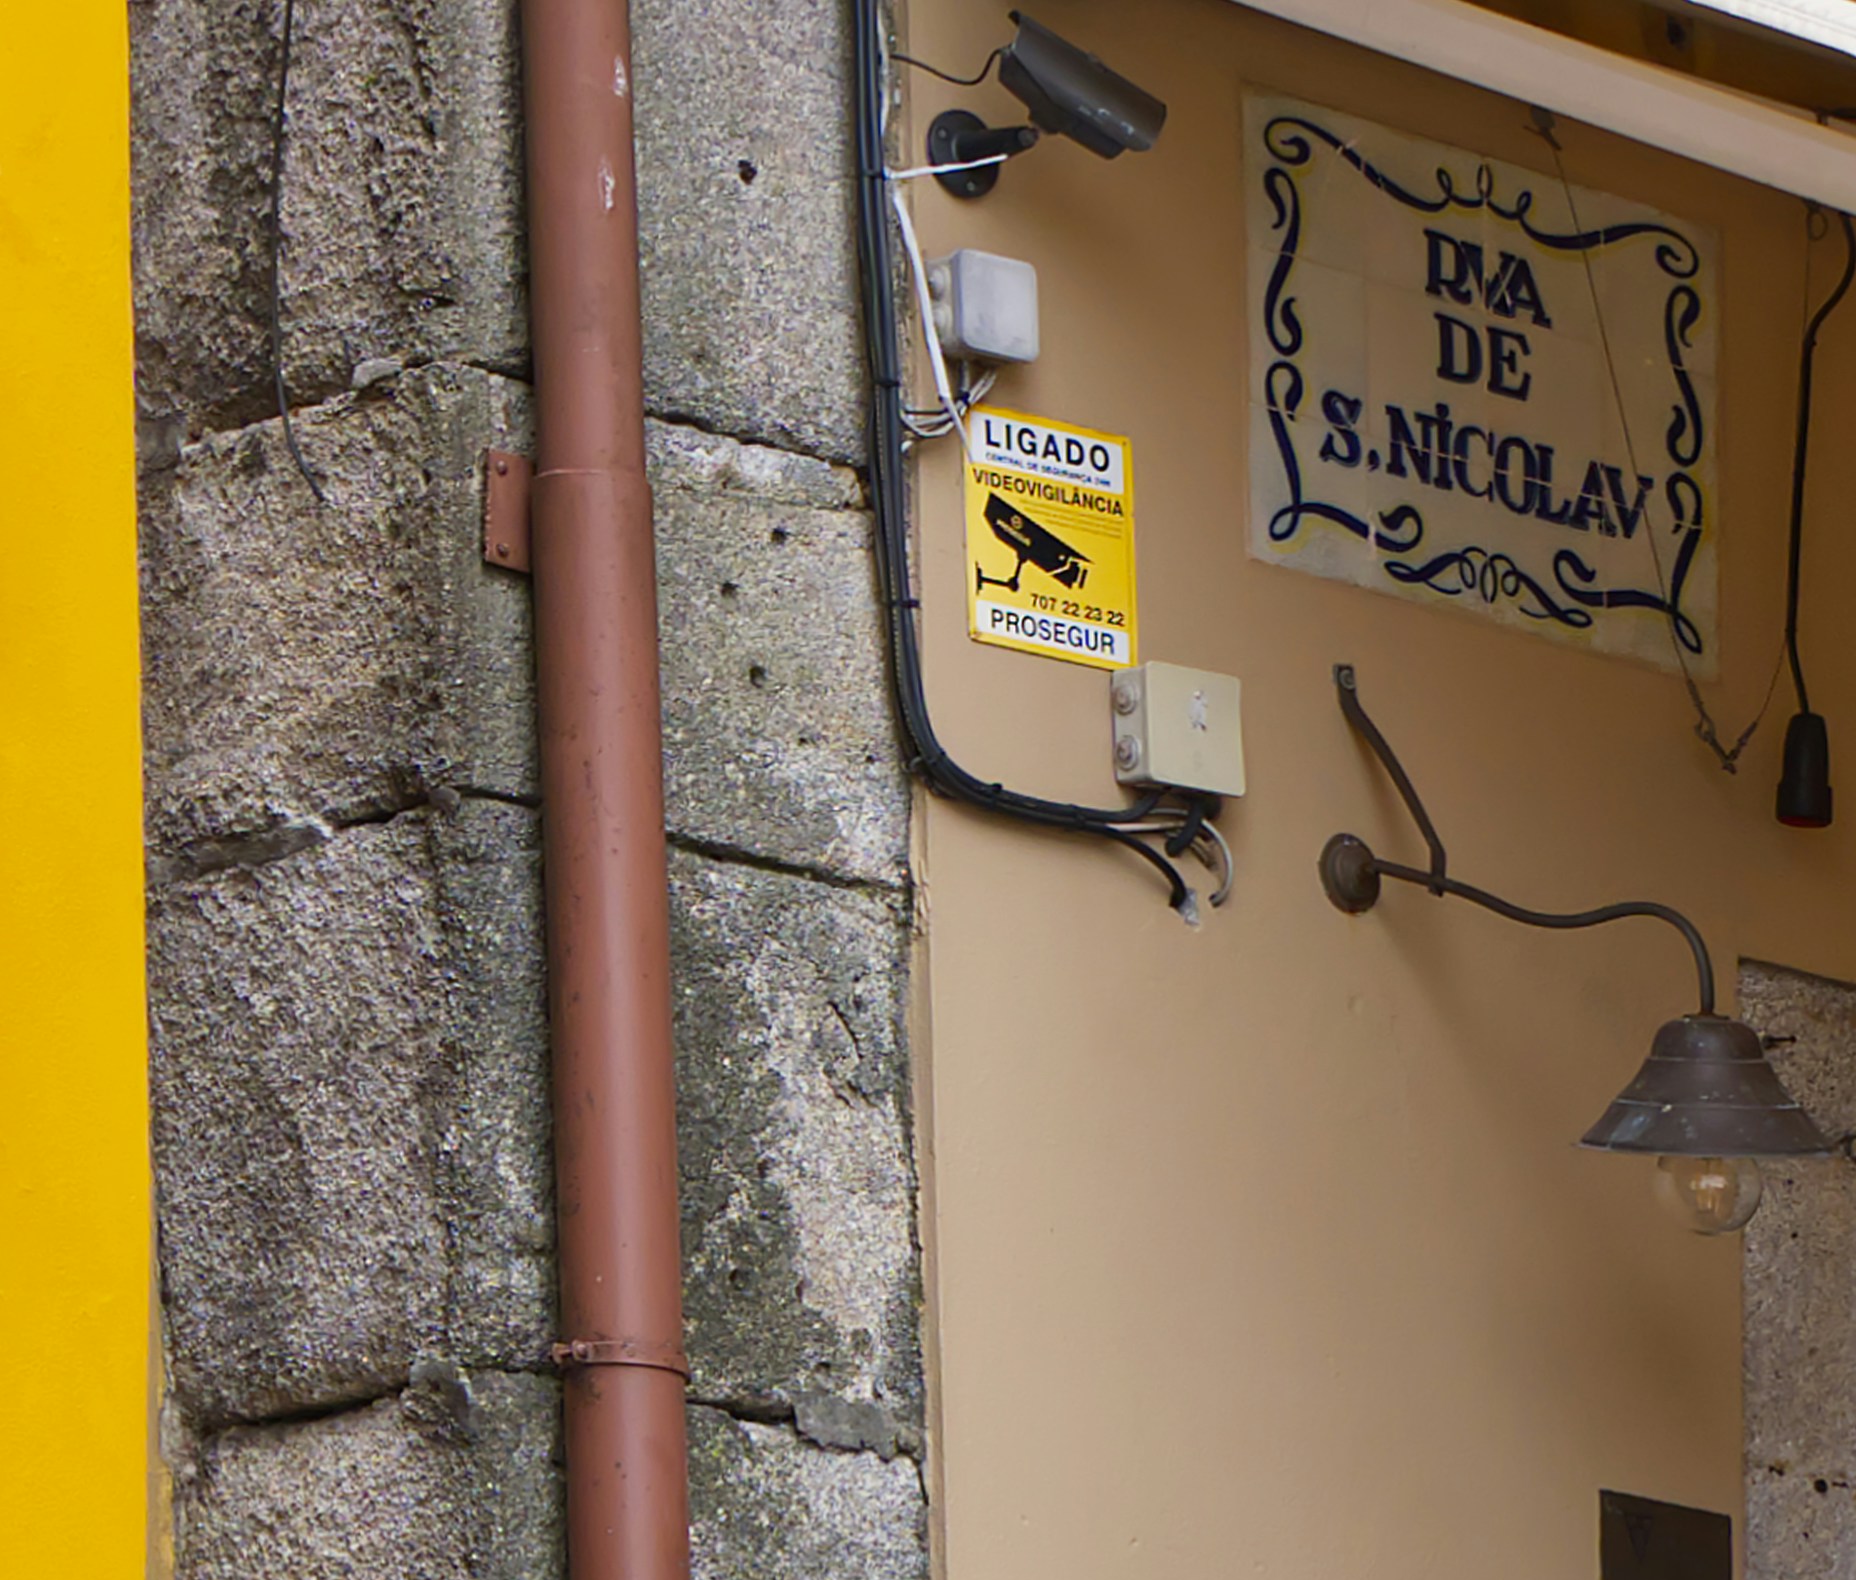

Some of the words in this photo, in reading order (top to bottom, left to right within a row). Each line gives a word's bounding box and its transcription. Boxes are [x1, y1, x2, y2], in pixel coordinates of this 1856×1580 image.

[1433, 312, 1532, 401] DE
[984, 419, 1111, 473] LIGADO
[972, 467, 1124, 517] VIDEOVIGILÂNCIA
[990, 608, 1116, 655] PROSEGUR
[1030, 592, 1057, 612] 707
[1061, 600, 1080, 618] 22
[1084, 605, 1103, 622] 23
[1106, 610, 1126, 628] 22
